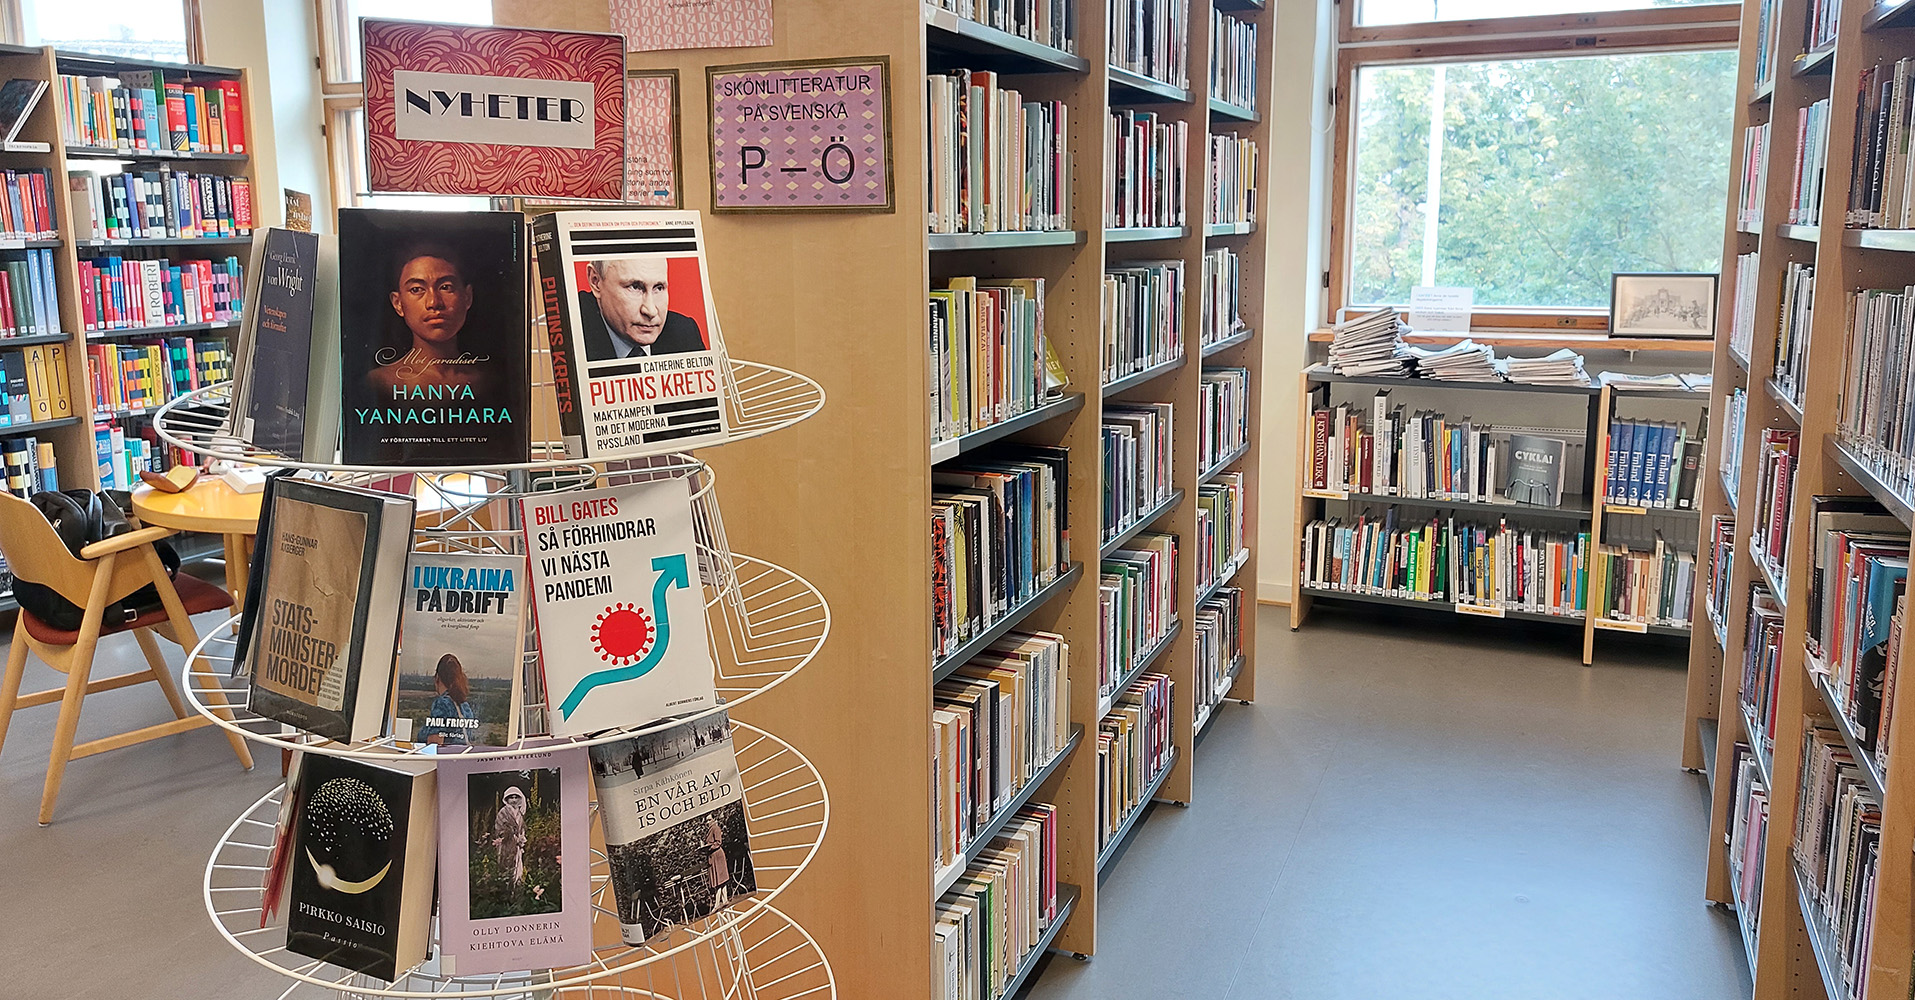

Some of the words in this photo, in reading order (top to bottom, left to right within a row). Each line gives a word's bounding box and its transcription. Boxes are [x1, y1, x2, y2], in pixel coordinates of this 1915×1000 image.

[724, 74, 871, 96] SKÖNLITTERATUR
[406, 88, 585, 124] NYHETER
[743, 104, 764, 122] PÅ
[769, 103, 848, 120] SVENSKA
[741, 146, 766, 184] P
[821, 136, 855, 184] Ö
[205, 177, 215, 215] OXFORD
[147, 263, 161, 308] ROBERT
[277, 265, 304, 297] Wright
[542, 276, 564, 346] PUTINS
[32, 350, 40, 362] A
[52, 348, 60, 359] P
[644, 359, 685, 373] CATHERINE
[686, 356, 714, 368] BELTON
[1045, 360, 1060, 371] NEY
[393, 384, 475, 400] HANYA
[552, 351, 573, 414] KRETS
[589, 376, 657, 406] PUTINS
[660, 369, 717, 398] KRETS
[355, 408, 513, 424] YANAGIHARA
[593, 405, 651, 423] MAKTKAMPEN
[595, 425, 609, 437] OM
[610, 423, 625, 434] DET
[628, 417, 666, 432] MODERNA
[597, 434, 640, 450] RYSSLAND
[1608, 450, 1618, 481] Finland
[1618, 450, 1629, 481] Finland
[1631, 451, 1642, 482] Finland
[1645, 453, 1656, 484] Finland
[1658, 453, 1670, 485] Finland
[1608, 486, 1613, 496] 1
[1617, 486, 1625, 496] 2
[1630, 487, 1638, 497] 3
[1643, 489, 1651, 500] 4
[1657, 490, 1664, 500] 5
[535, 504, 568, 525] BILL
[571, 497, 619, 521] GATES
[538, 526, 559, 552] SÅ
[562, 517, 657, 548] FÖRHINDRAR
[541, 557, 557, 577] VI
[560, 550, 610, 575] NÄSTA
[413, 566, 421, 588] I
[423, 567, 515, 592] UKRAINA
[545, 575, 613, 603] PANDEMI
[416, 585, 442, 612] PÅ
[445, 590, 509, 614] DRIFT
[272, 599, 318, 635] STATS-
[266, 653, 326, 697] MORDET
[426, 717, 445, 727] PAUL
[446, 718, 479, 729] FRIGYES
[633, 786, 654, 796] Sirpa
[655, 768, 693, 788] Kähkönen
[635, 793, 661, 813] EN
[664, 779, 698, 801] VÅR
[702, 770, 721, 788] AV
[638, 812, 656, 829] IS
[660, 797, 695, 820] OCH
[698, 783, 731, 806] ELD
[299, 902, 343, 924] PIRKKO
[345, 916, 386, 936] SAISIO
[472, 927, 500, 936] OLLY
[505, 921, 560, 934] DONNERIN
[322, 931, 358, 948] Passio
[469, 939, 524, 951] KIEHTOVA
[530, 934, 564, 946] ELÄMÄ
